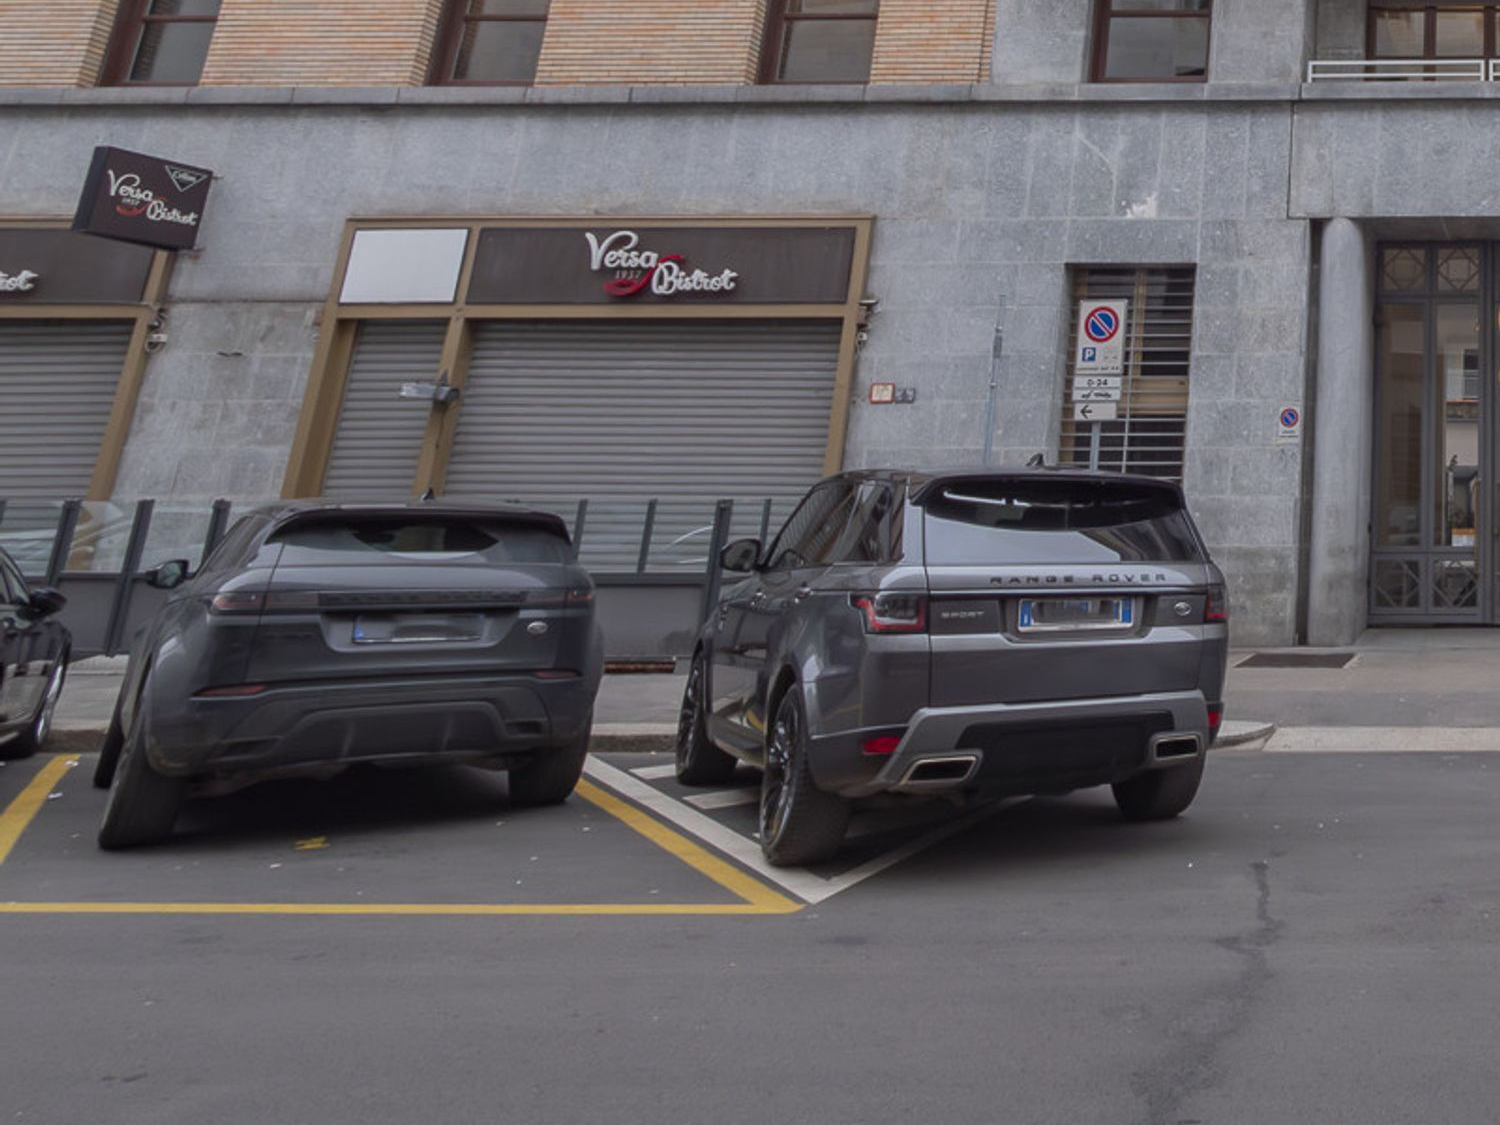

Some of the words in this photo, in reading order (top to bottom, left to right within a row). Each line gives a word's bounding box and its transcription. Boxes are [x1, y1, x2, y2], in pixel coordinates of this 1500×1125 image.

[107, 169, 153, 202] Versa
[145, 200, 199, 226] Bistrot
[585, 230, 659, 271] Versa
[652, 261, 738, 295] Bistrot
[990, 574, 1075, 585] RANGE
[1092, 573, 1166, 583] ROVER
